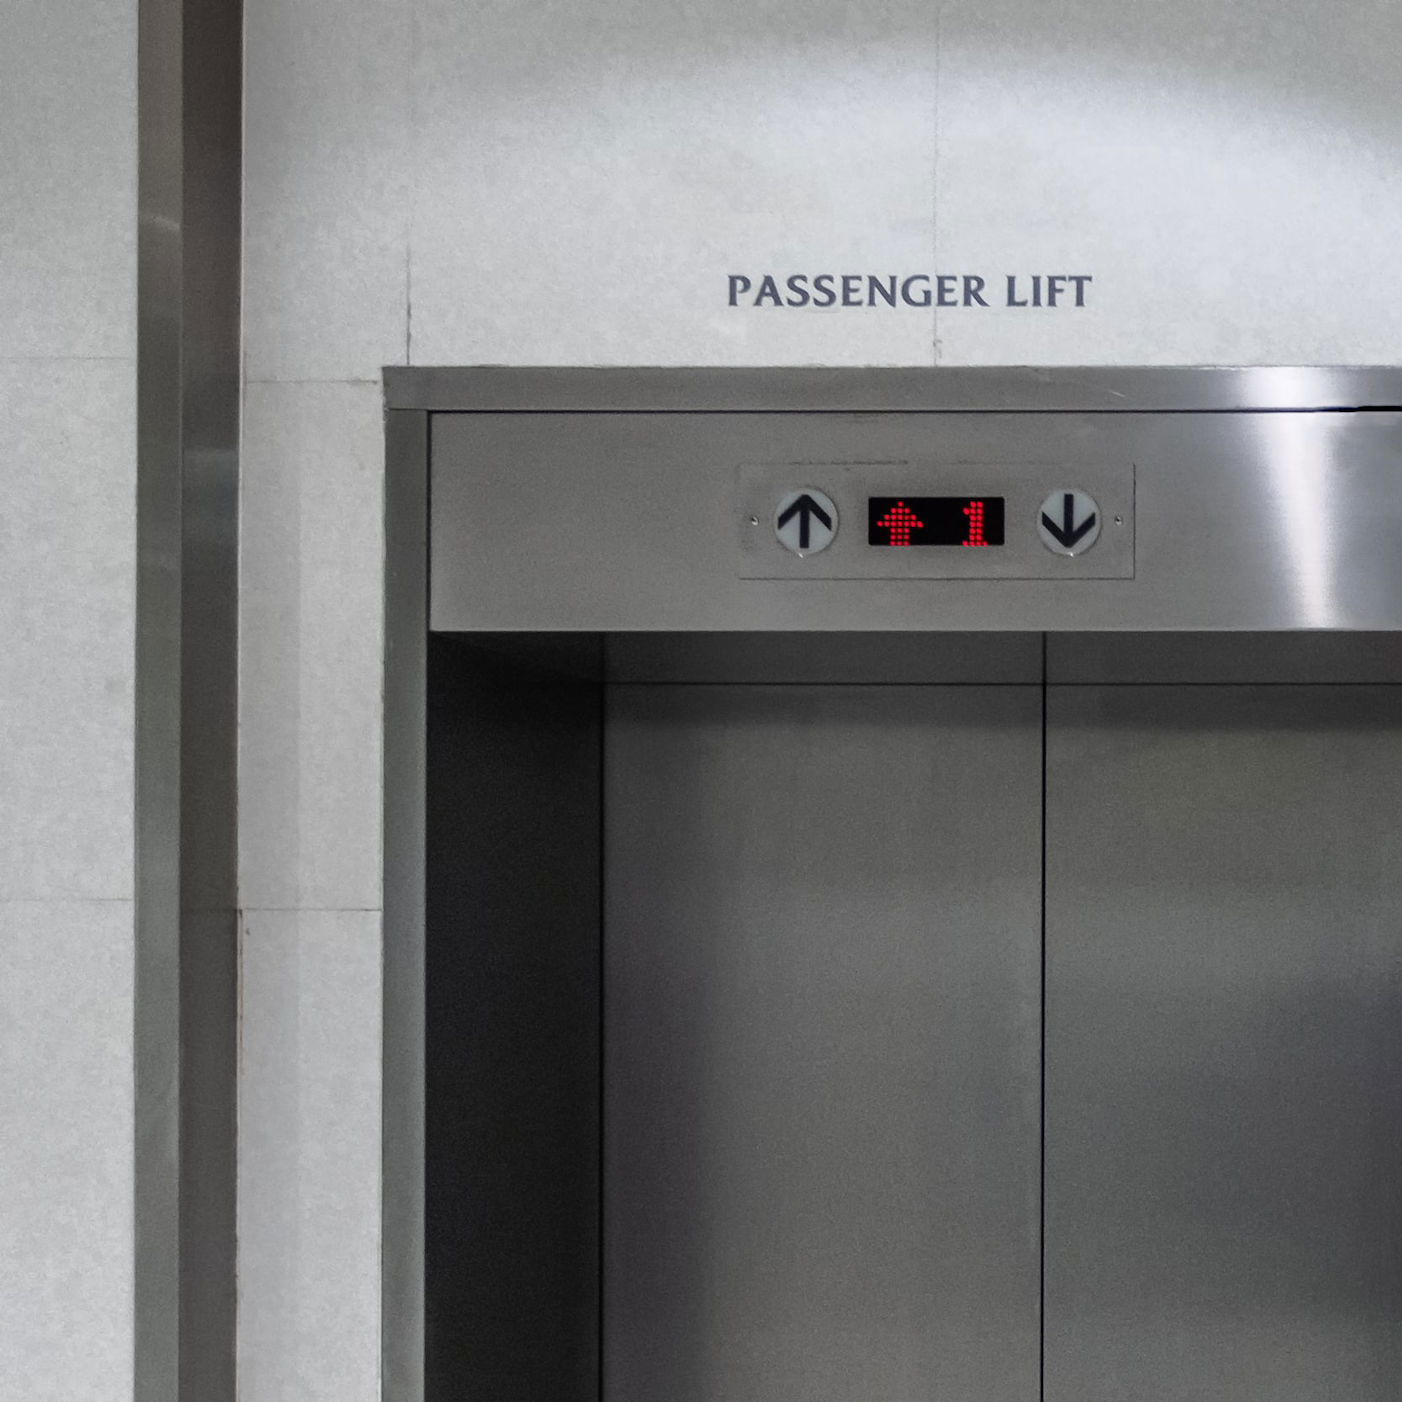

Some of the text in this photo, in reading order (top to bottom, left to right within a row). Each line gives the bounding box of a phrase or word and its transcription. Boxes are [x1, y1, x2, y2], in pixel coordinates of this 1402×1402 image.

[727, 274, 1093, 308] PASSENGER LIFT
[962, 501, 987, 546] 1
